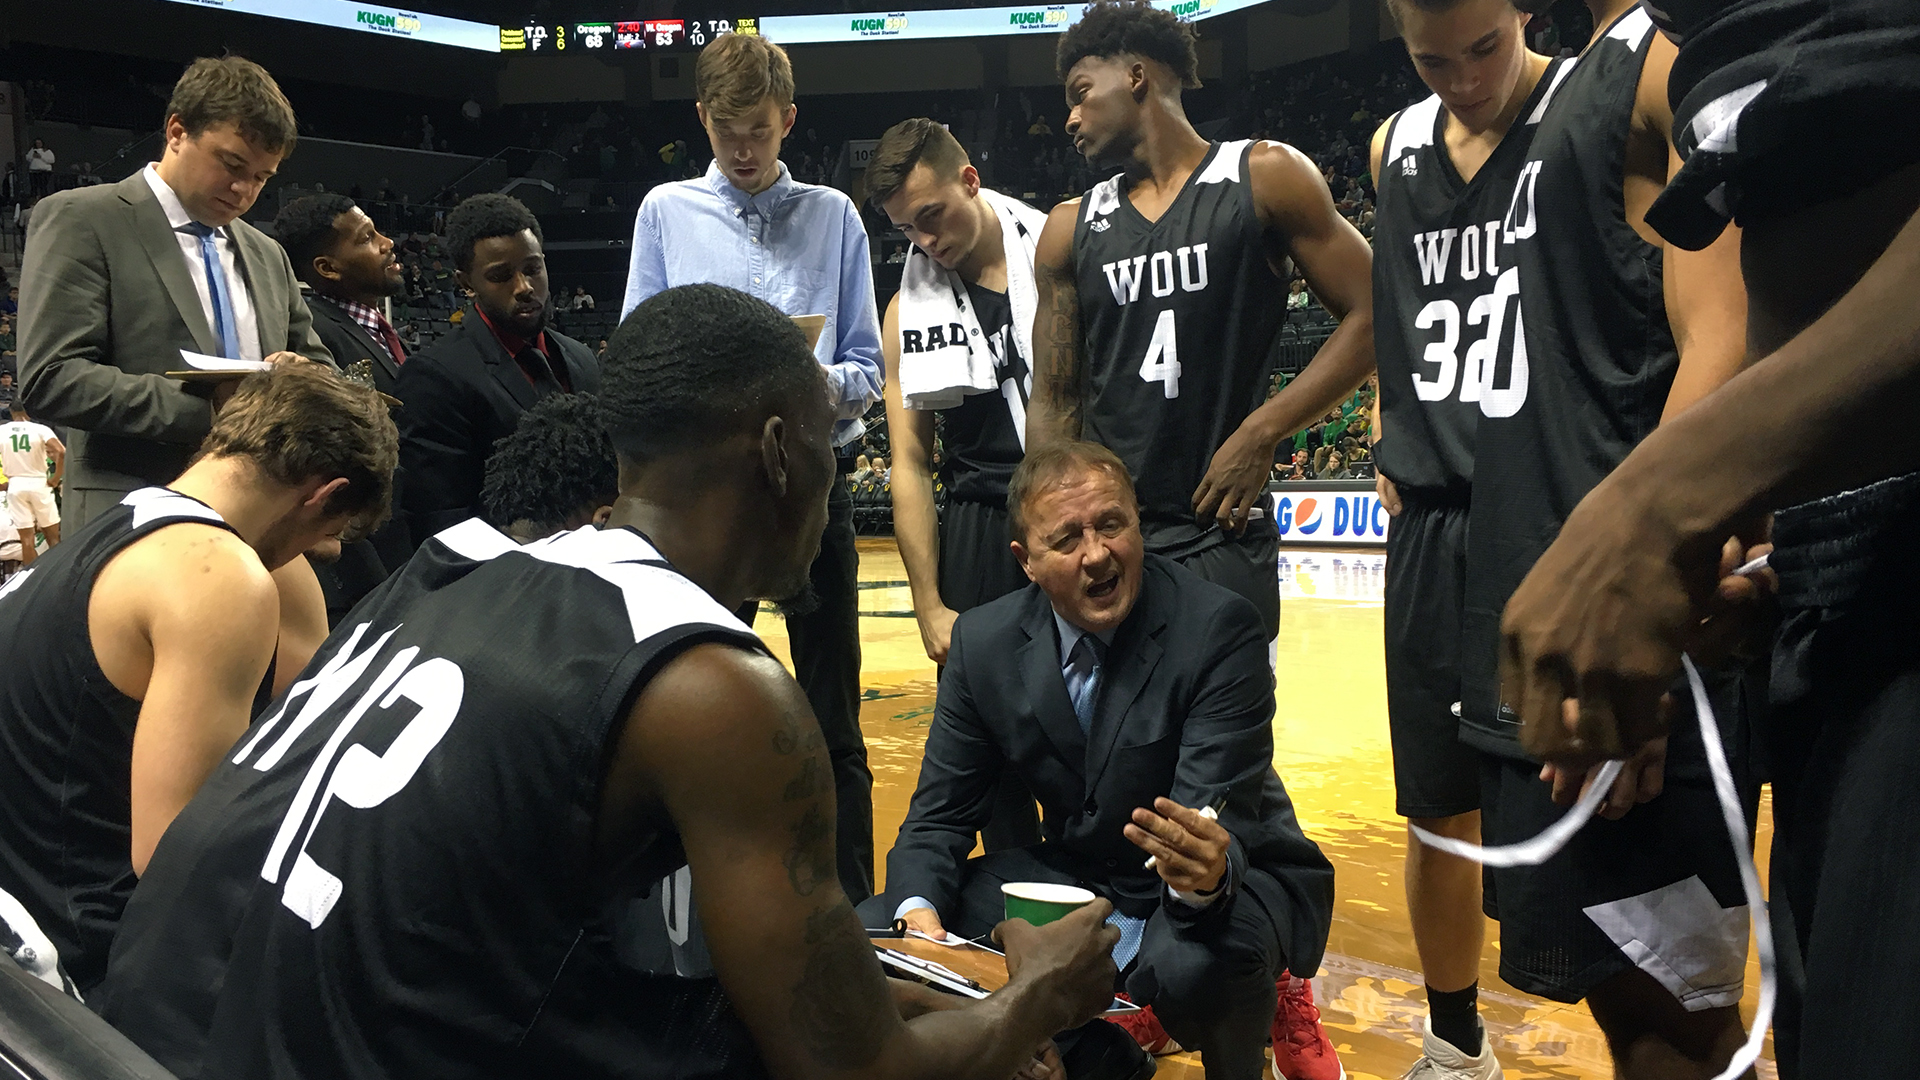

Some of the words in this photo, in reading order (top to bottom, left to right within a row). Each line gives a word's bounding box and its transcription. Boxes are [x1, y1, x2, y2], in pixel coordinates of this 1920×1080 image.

[1171, 0, 1200, 16] KUGN
[357, 11, 395, 27] KUGN
[396, 16, 422, 32] 590
[1010, 12, 1044, 24] KUGN
[1045, 10, 1068, 23] 590
[577, 25, 612, 35] Oregon
[656, 23, 682, 34] Oregon
[692, 22, 700, 33] 2
[851, 19, 885, 31] KUGN
[886, 17, 908, 29] 590
[556, 26, 565, 38] 3
[532, 39, 541, 51] F
[556, 38, 565, 50] 6
[585, 35, 603, 48] 68
[656, 33, 673, 46] 53
[690, 33, 705, 46] 10
[1103, 243, 1208, 306] WOU
[1139, 309, 1181, 399] 4
[9, 434, 31, 453] 14
